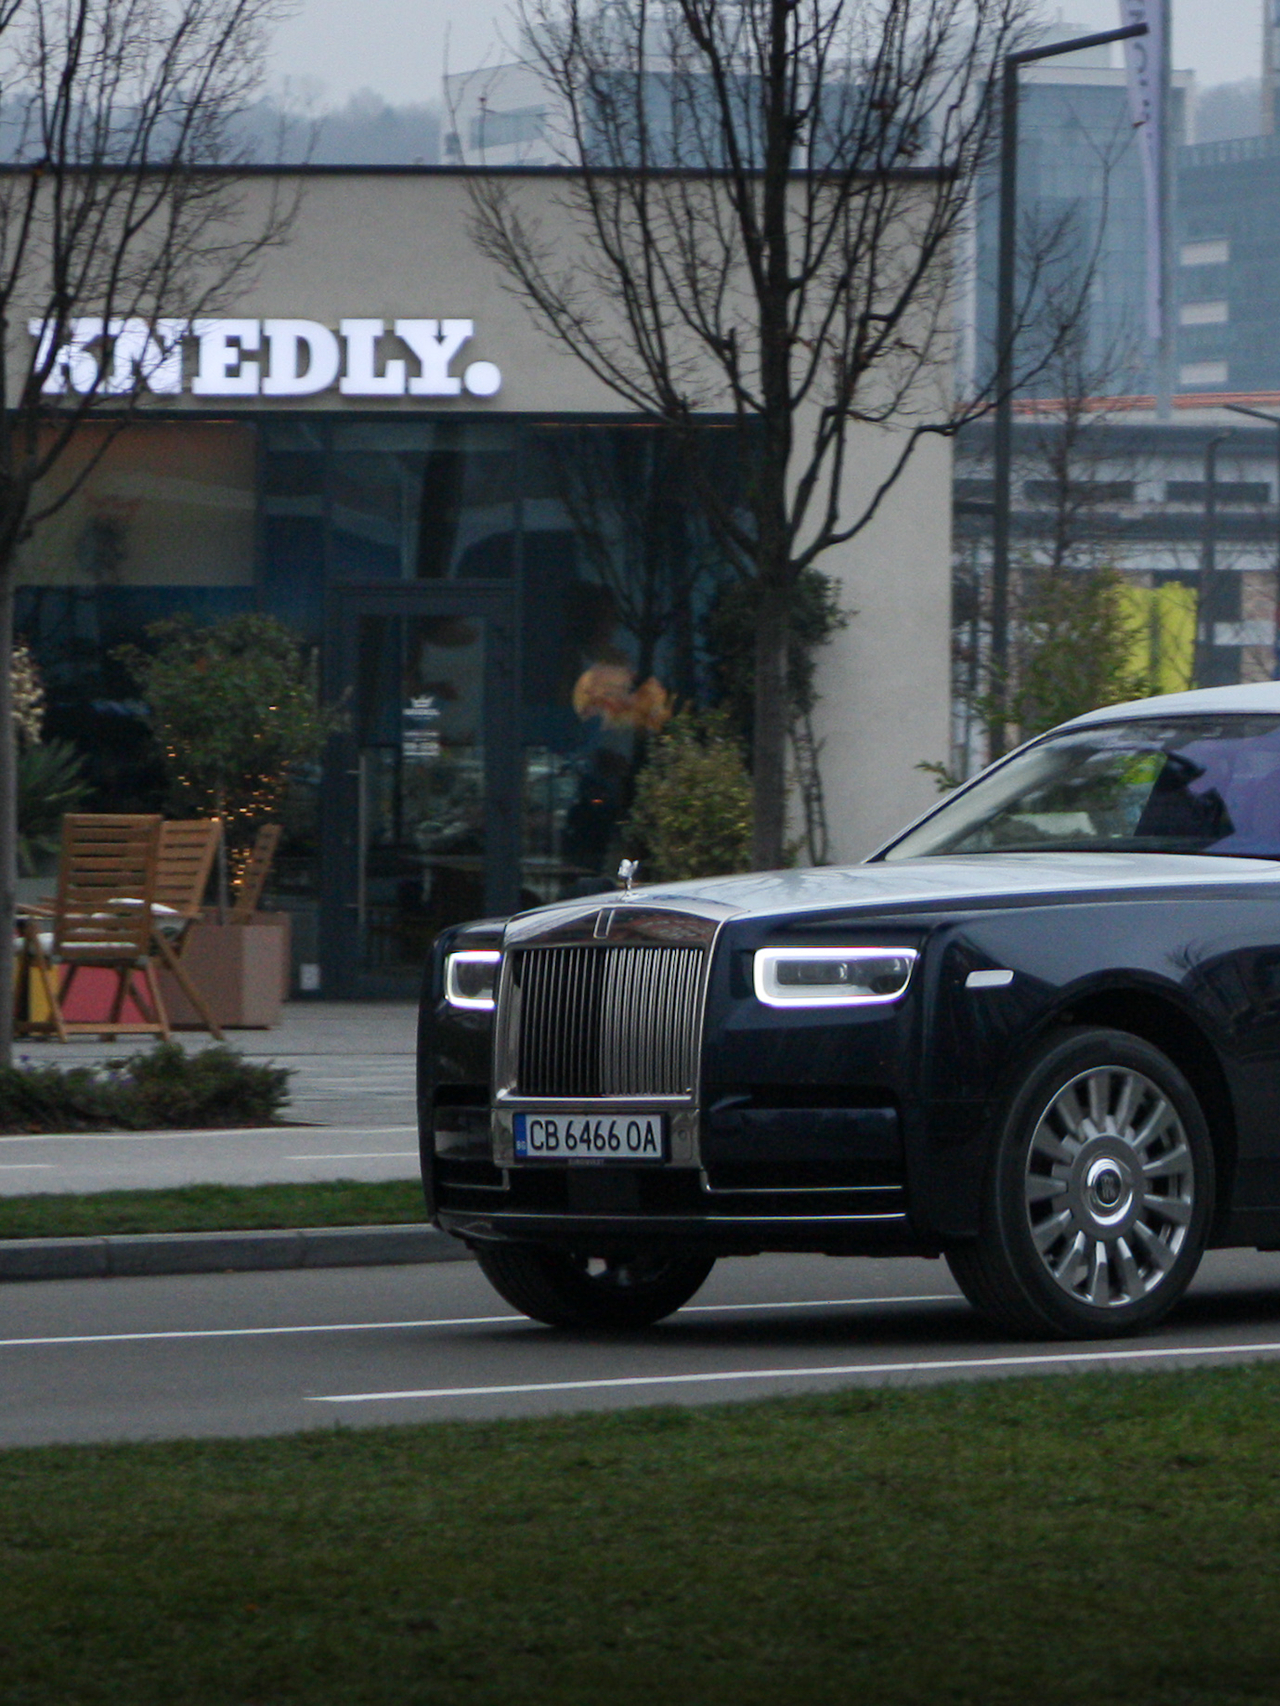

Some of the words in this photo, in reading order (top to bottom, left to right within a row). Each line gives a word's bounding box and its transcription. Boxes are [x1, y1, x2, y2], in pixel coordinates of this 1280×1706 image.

[28, 317, 501, 396] KNEDLY.
[530, 1120, 559, 1151] CB
[565, 1120, 621, 1151] 6466
[626, 1120, 657, 1152] OA
